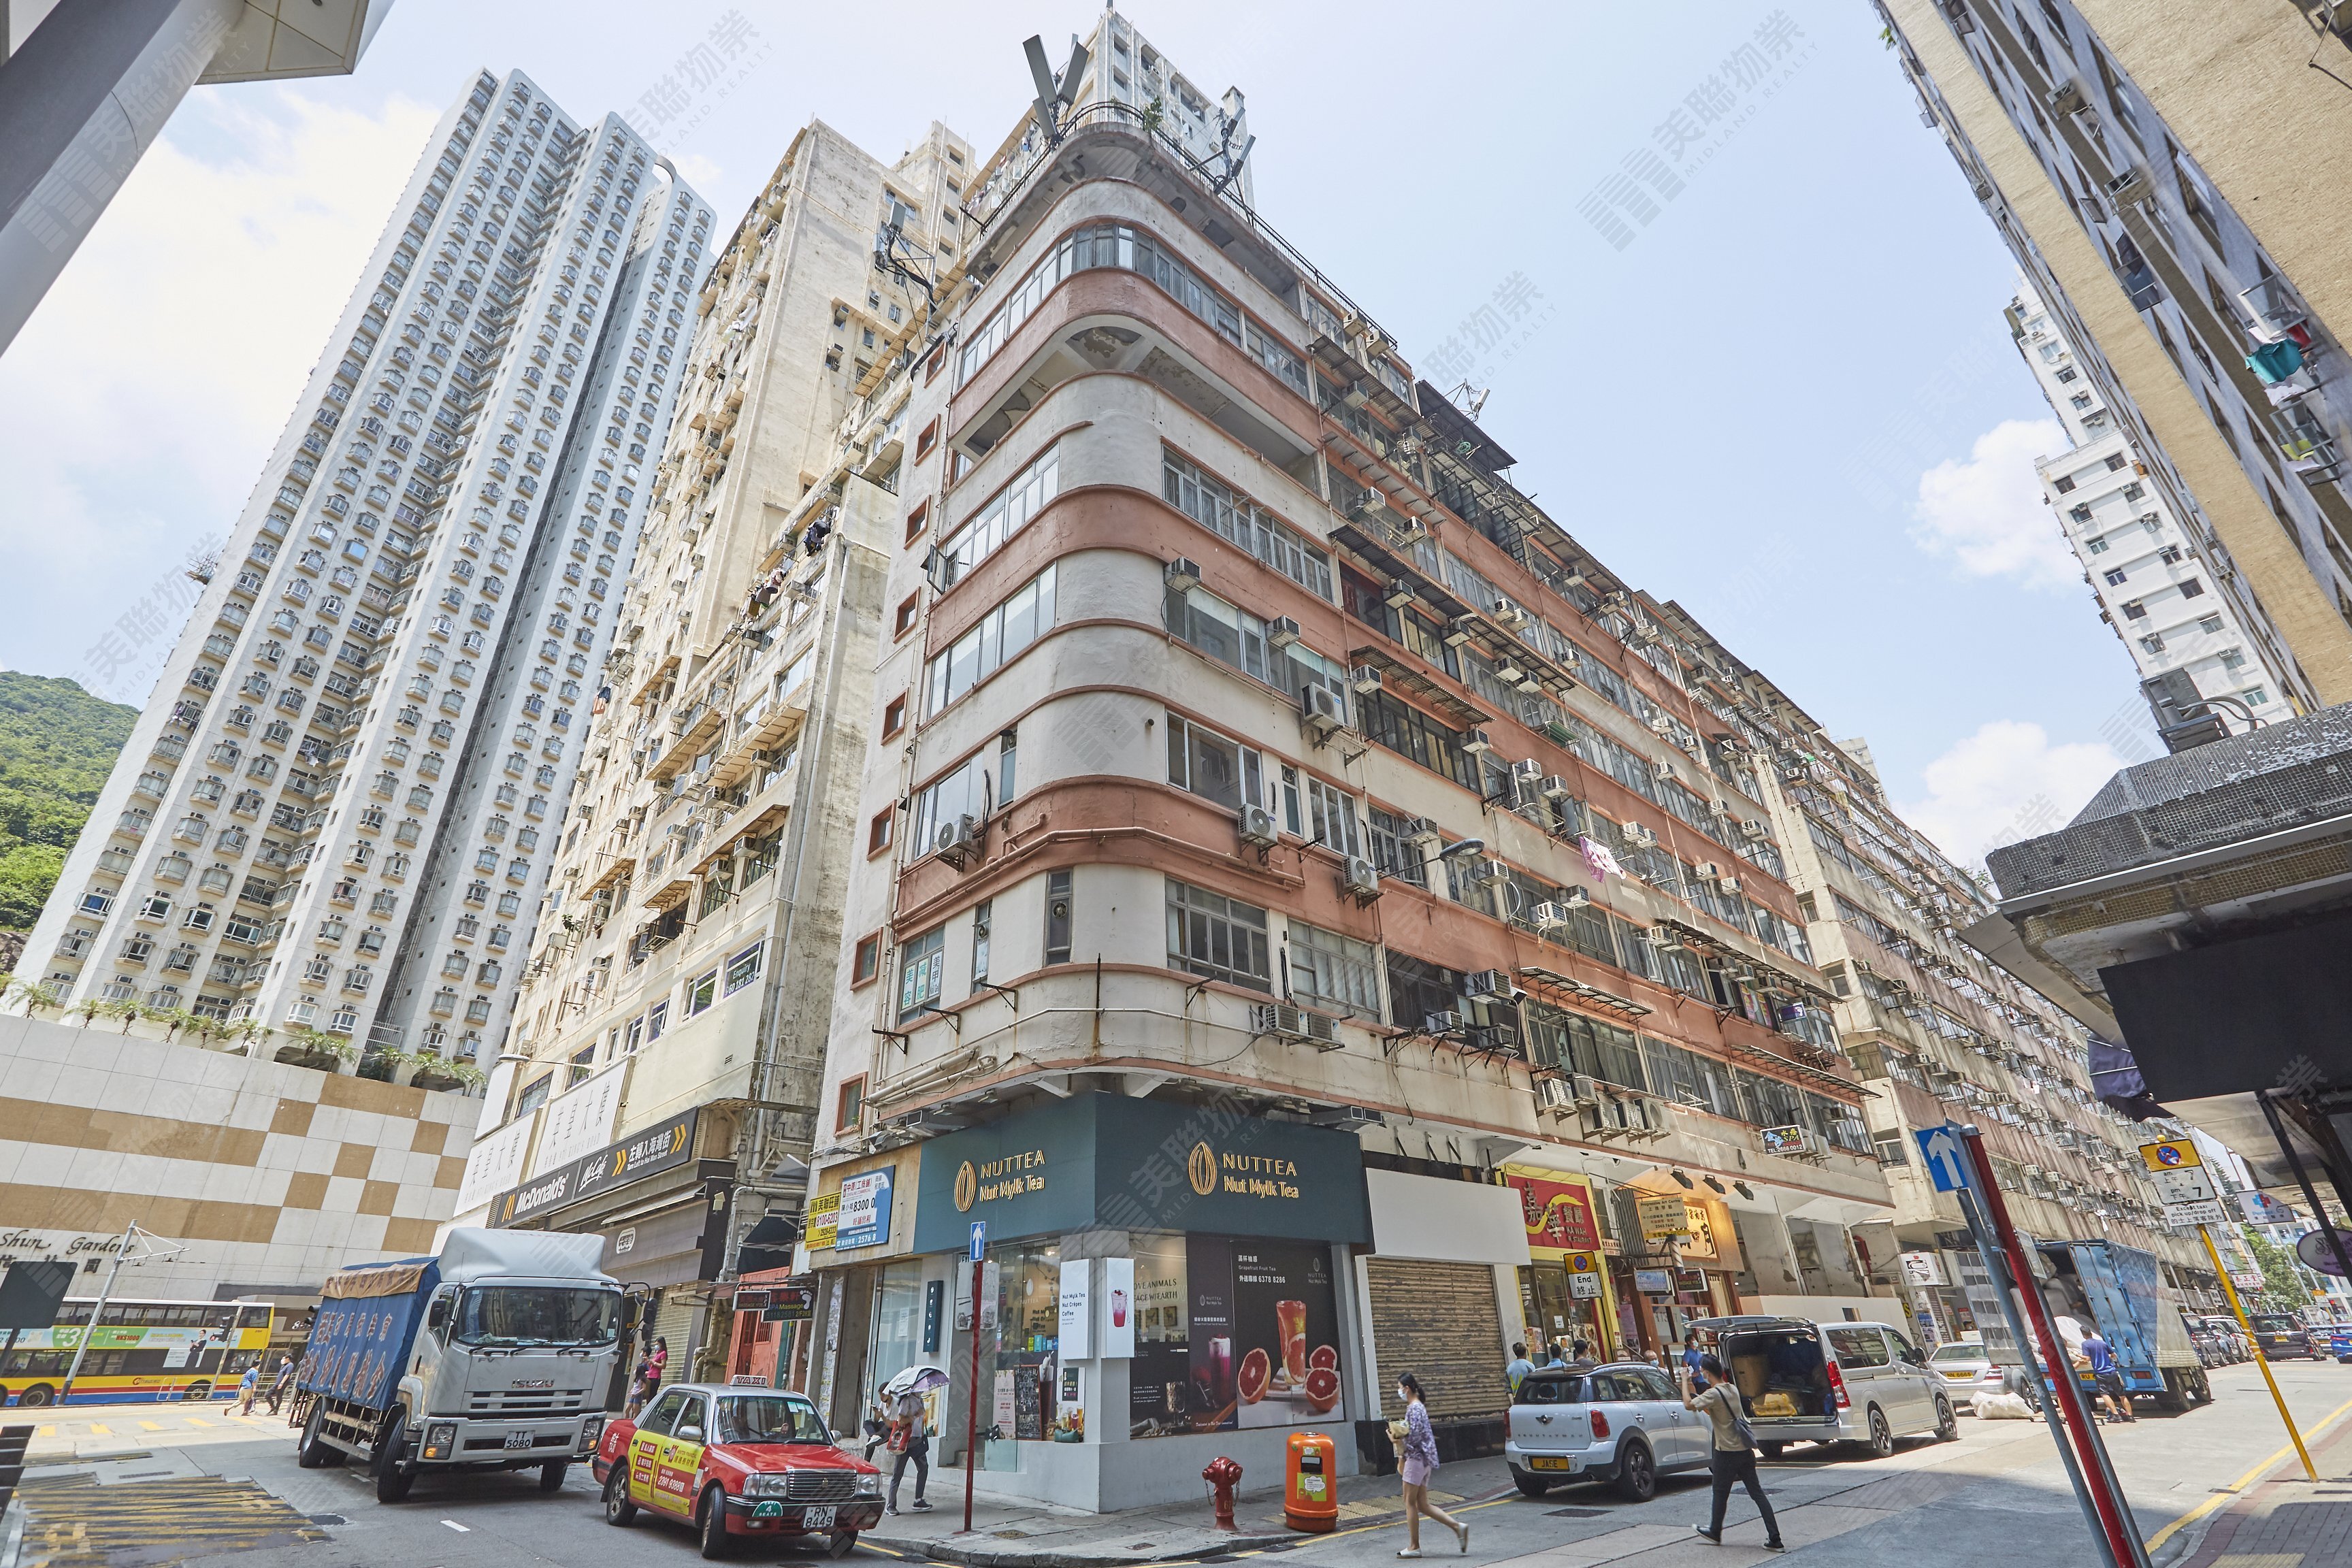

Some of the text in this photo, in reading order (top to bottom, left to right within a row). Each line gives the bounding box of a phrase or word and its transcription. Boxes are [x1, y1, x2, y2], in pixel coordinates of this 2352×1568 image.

[981, 1149, 1045, 1179] NUTTEA
[1223, 1153, 1297, 1177] NUTTEA
[2184, 1169, 2194, 1180] 7
[979, 1174, 1045, 1202] Nut Mylk Tea
[1224, 1175, 1299, 1199] Nut Mylk Tea
[2192, 1186, 2202, 1197] 7
[514, 1177, 566, 1214] McDonald's
[853, 1198, 869, 1212] 8300
[870, 1197, 875, 1209] 0
[1522, 1180, 1565, 1244] 嘉華
[1566, 1226, 1587, 1236] KA WAH
[0, 1229, 52, 1250] Shun
[858, 1235, 871, 1243] 2576
[872, 1233, 877, 1241] 8
[1134, 1278, 1177, 1290] OVE ANIMALS
[1577, 1275, 1592, 1284] End
[1576, 1285, 1597, 1295] 終止
[1134, 1293, 1149, 1303] EACE
[512, 1379, 555, 1388] ISUZU
[737, 1376, 767, 1385] TAXI
[516, 1431, 527, 1439] TT
[506, 1439, 531, 1448] 5080
[814, 1507, 828, 1516] RN
[806, 1516, 833, 1526] 8449
